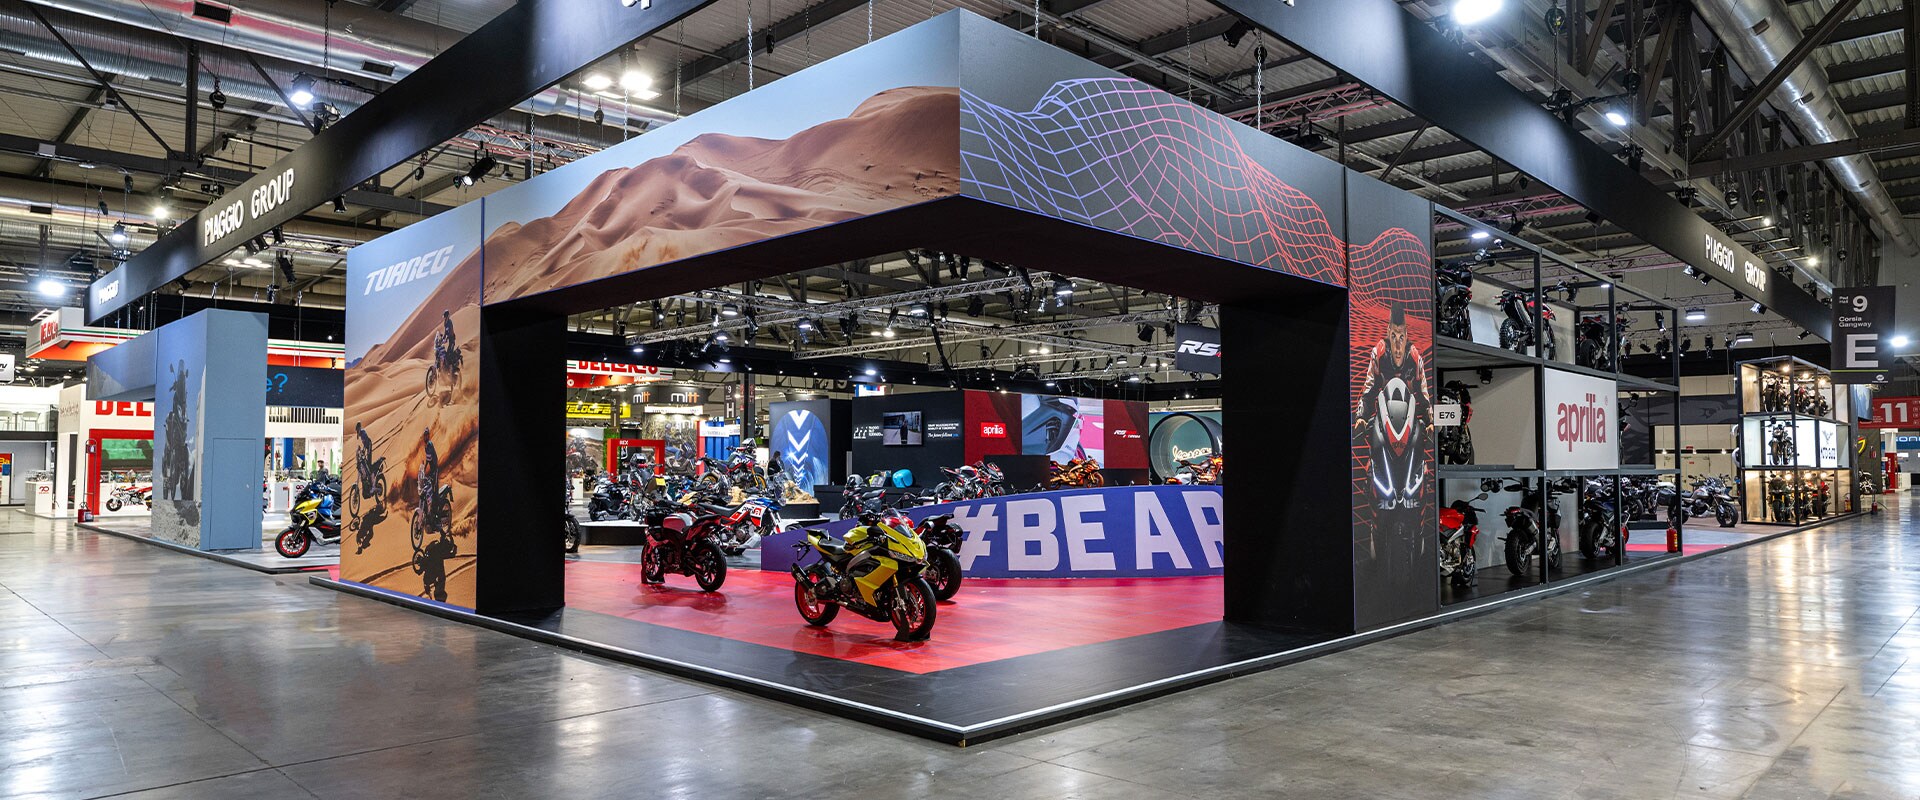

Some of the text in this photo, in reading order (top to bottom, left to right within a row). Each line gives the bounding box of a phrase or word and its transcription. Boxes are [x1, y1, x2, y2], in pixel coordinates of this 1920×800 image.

[205, 168, 294, 247] PIAGGIO GROUP
[364, 245, 455, 296] TUAREG
[1705, 234, 1767, 292] PIAGGIO GROUP
[1853, 295, 1868, 312] 9
[1846, 333, 1879, 368] E
[726, 402, 735, 418] H
[1439, 411, 1456, 420] E76
[1880, 402, 1908, 423] 11
[983, 424, 1004, 436] aprilia
[1557, 393, 1606, 452] aprilia
[1172, 445, 1212, 462] Vespa
